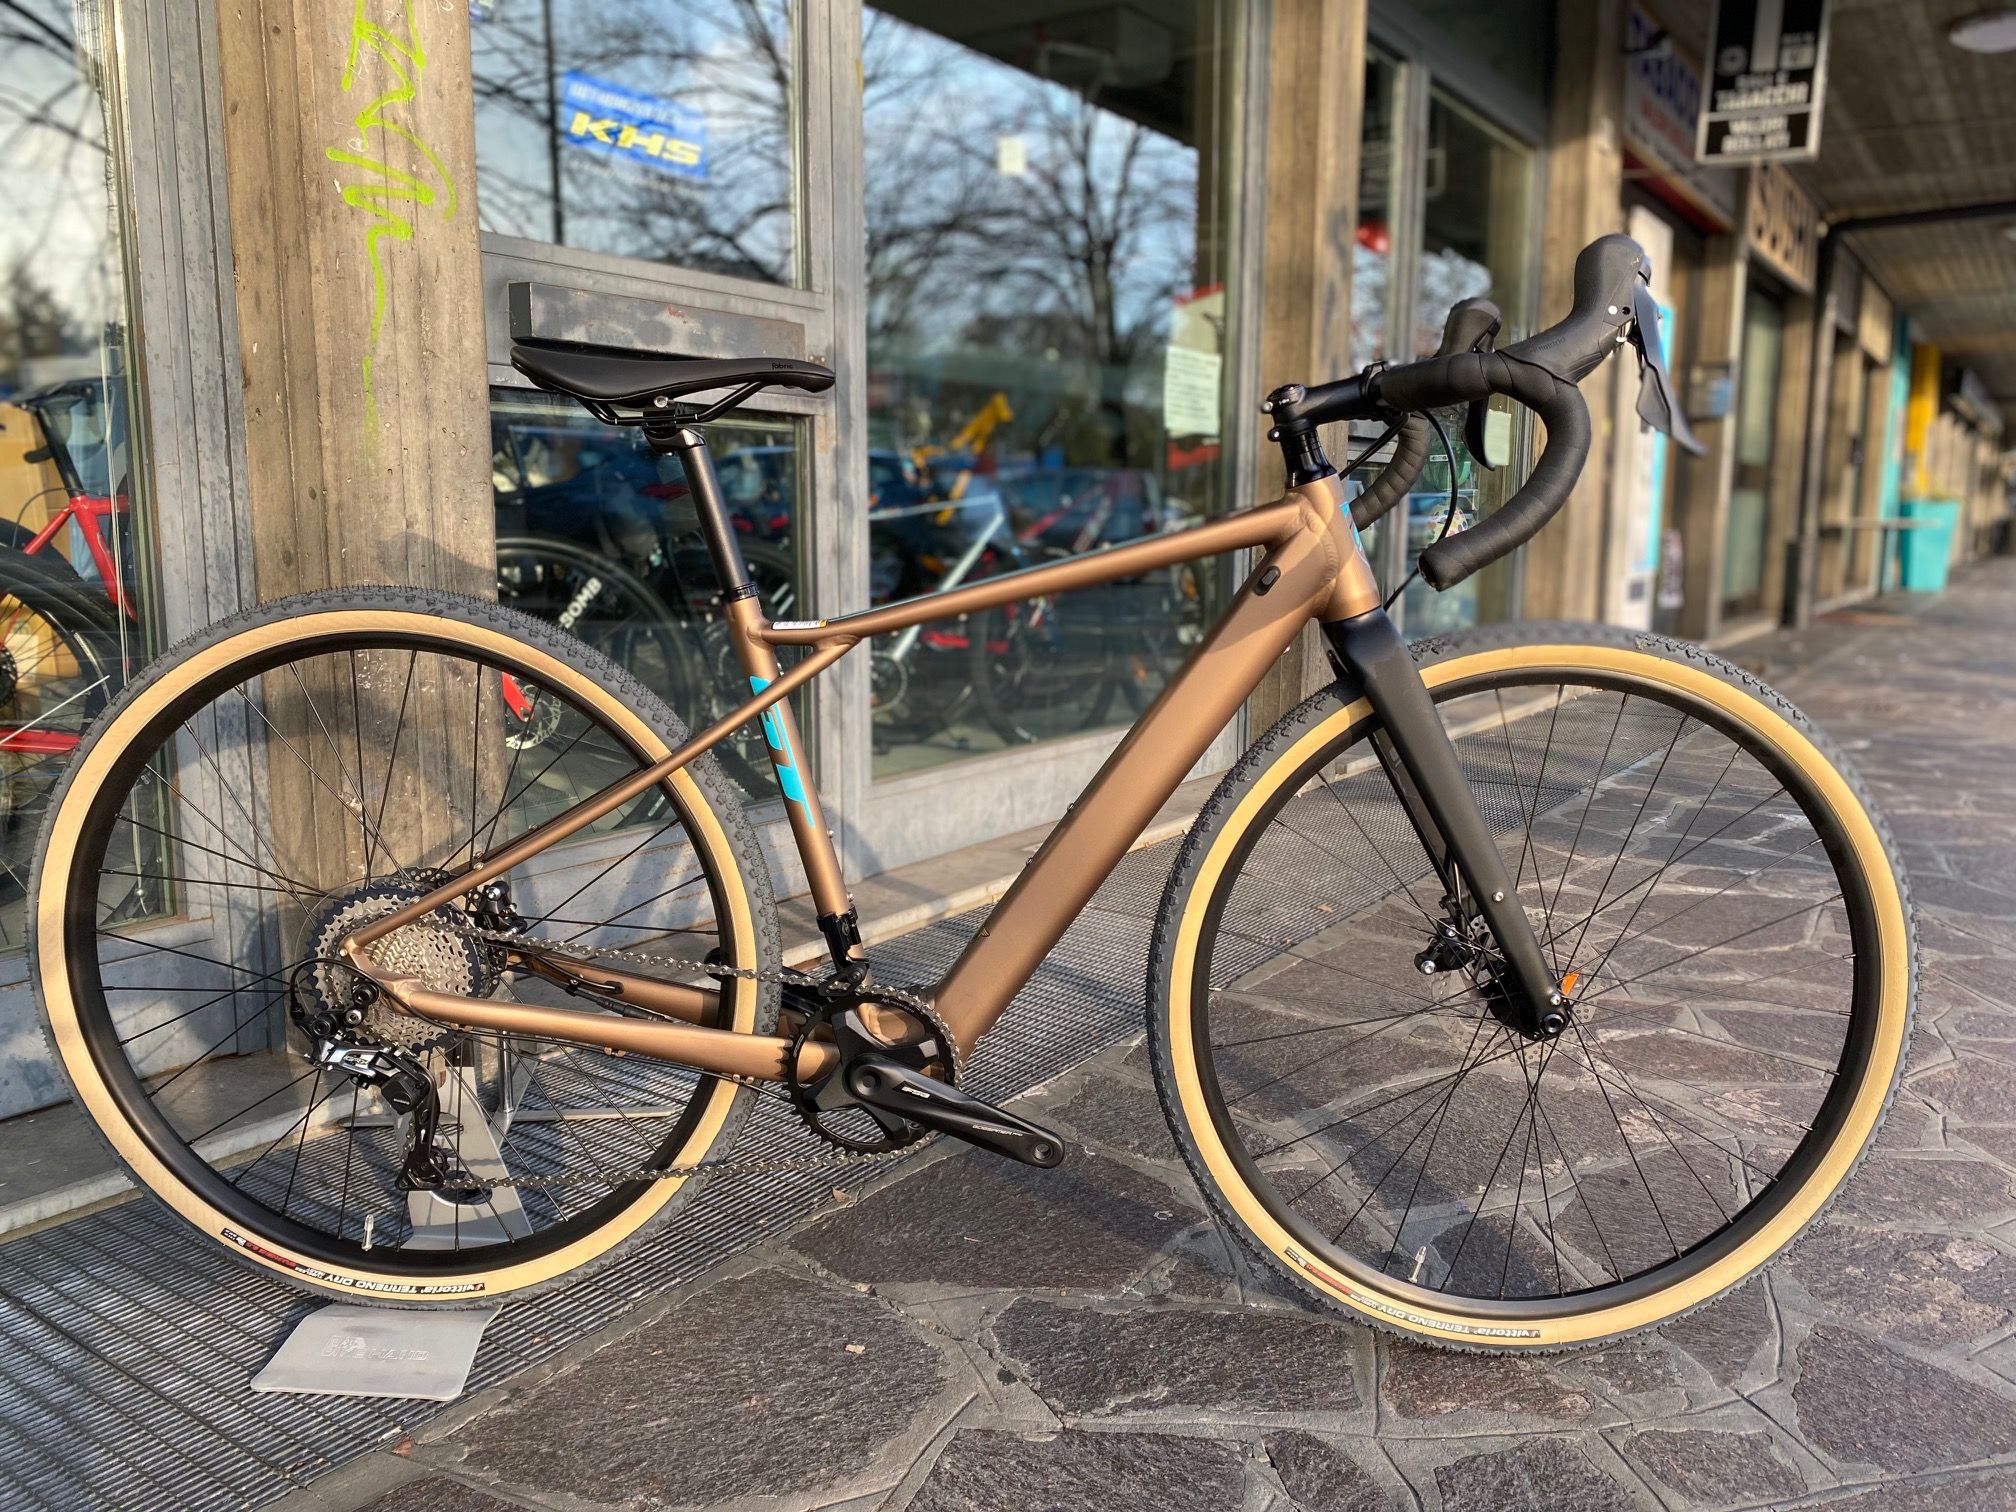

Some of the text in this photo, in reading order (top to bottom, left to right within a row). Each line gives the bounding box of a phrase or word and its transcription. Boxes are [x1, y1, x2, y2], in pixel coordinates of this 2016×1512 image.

[570, 112, 702, 166] KHS
[325, 1274, 354, 1285] DRY
[356, 1280, 417, 1294] TERRENO
[1379, 1305, 1405, 1318] DRY
[1408, 1315, 1470, 1334] TERRENO
